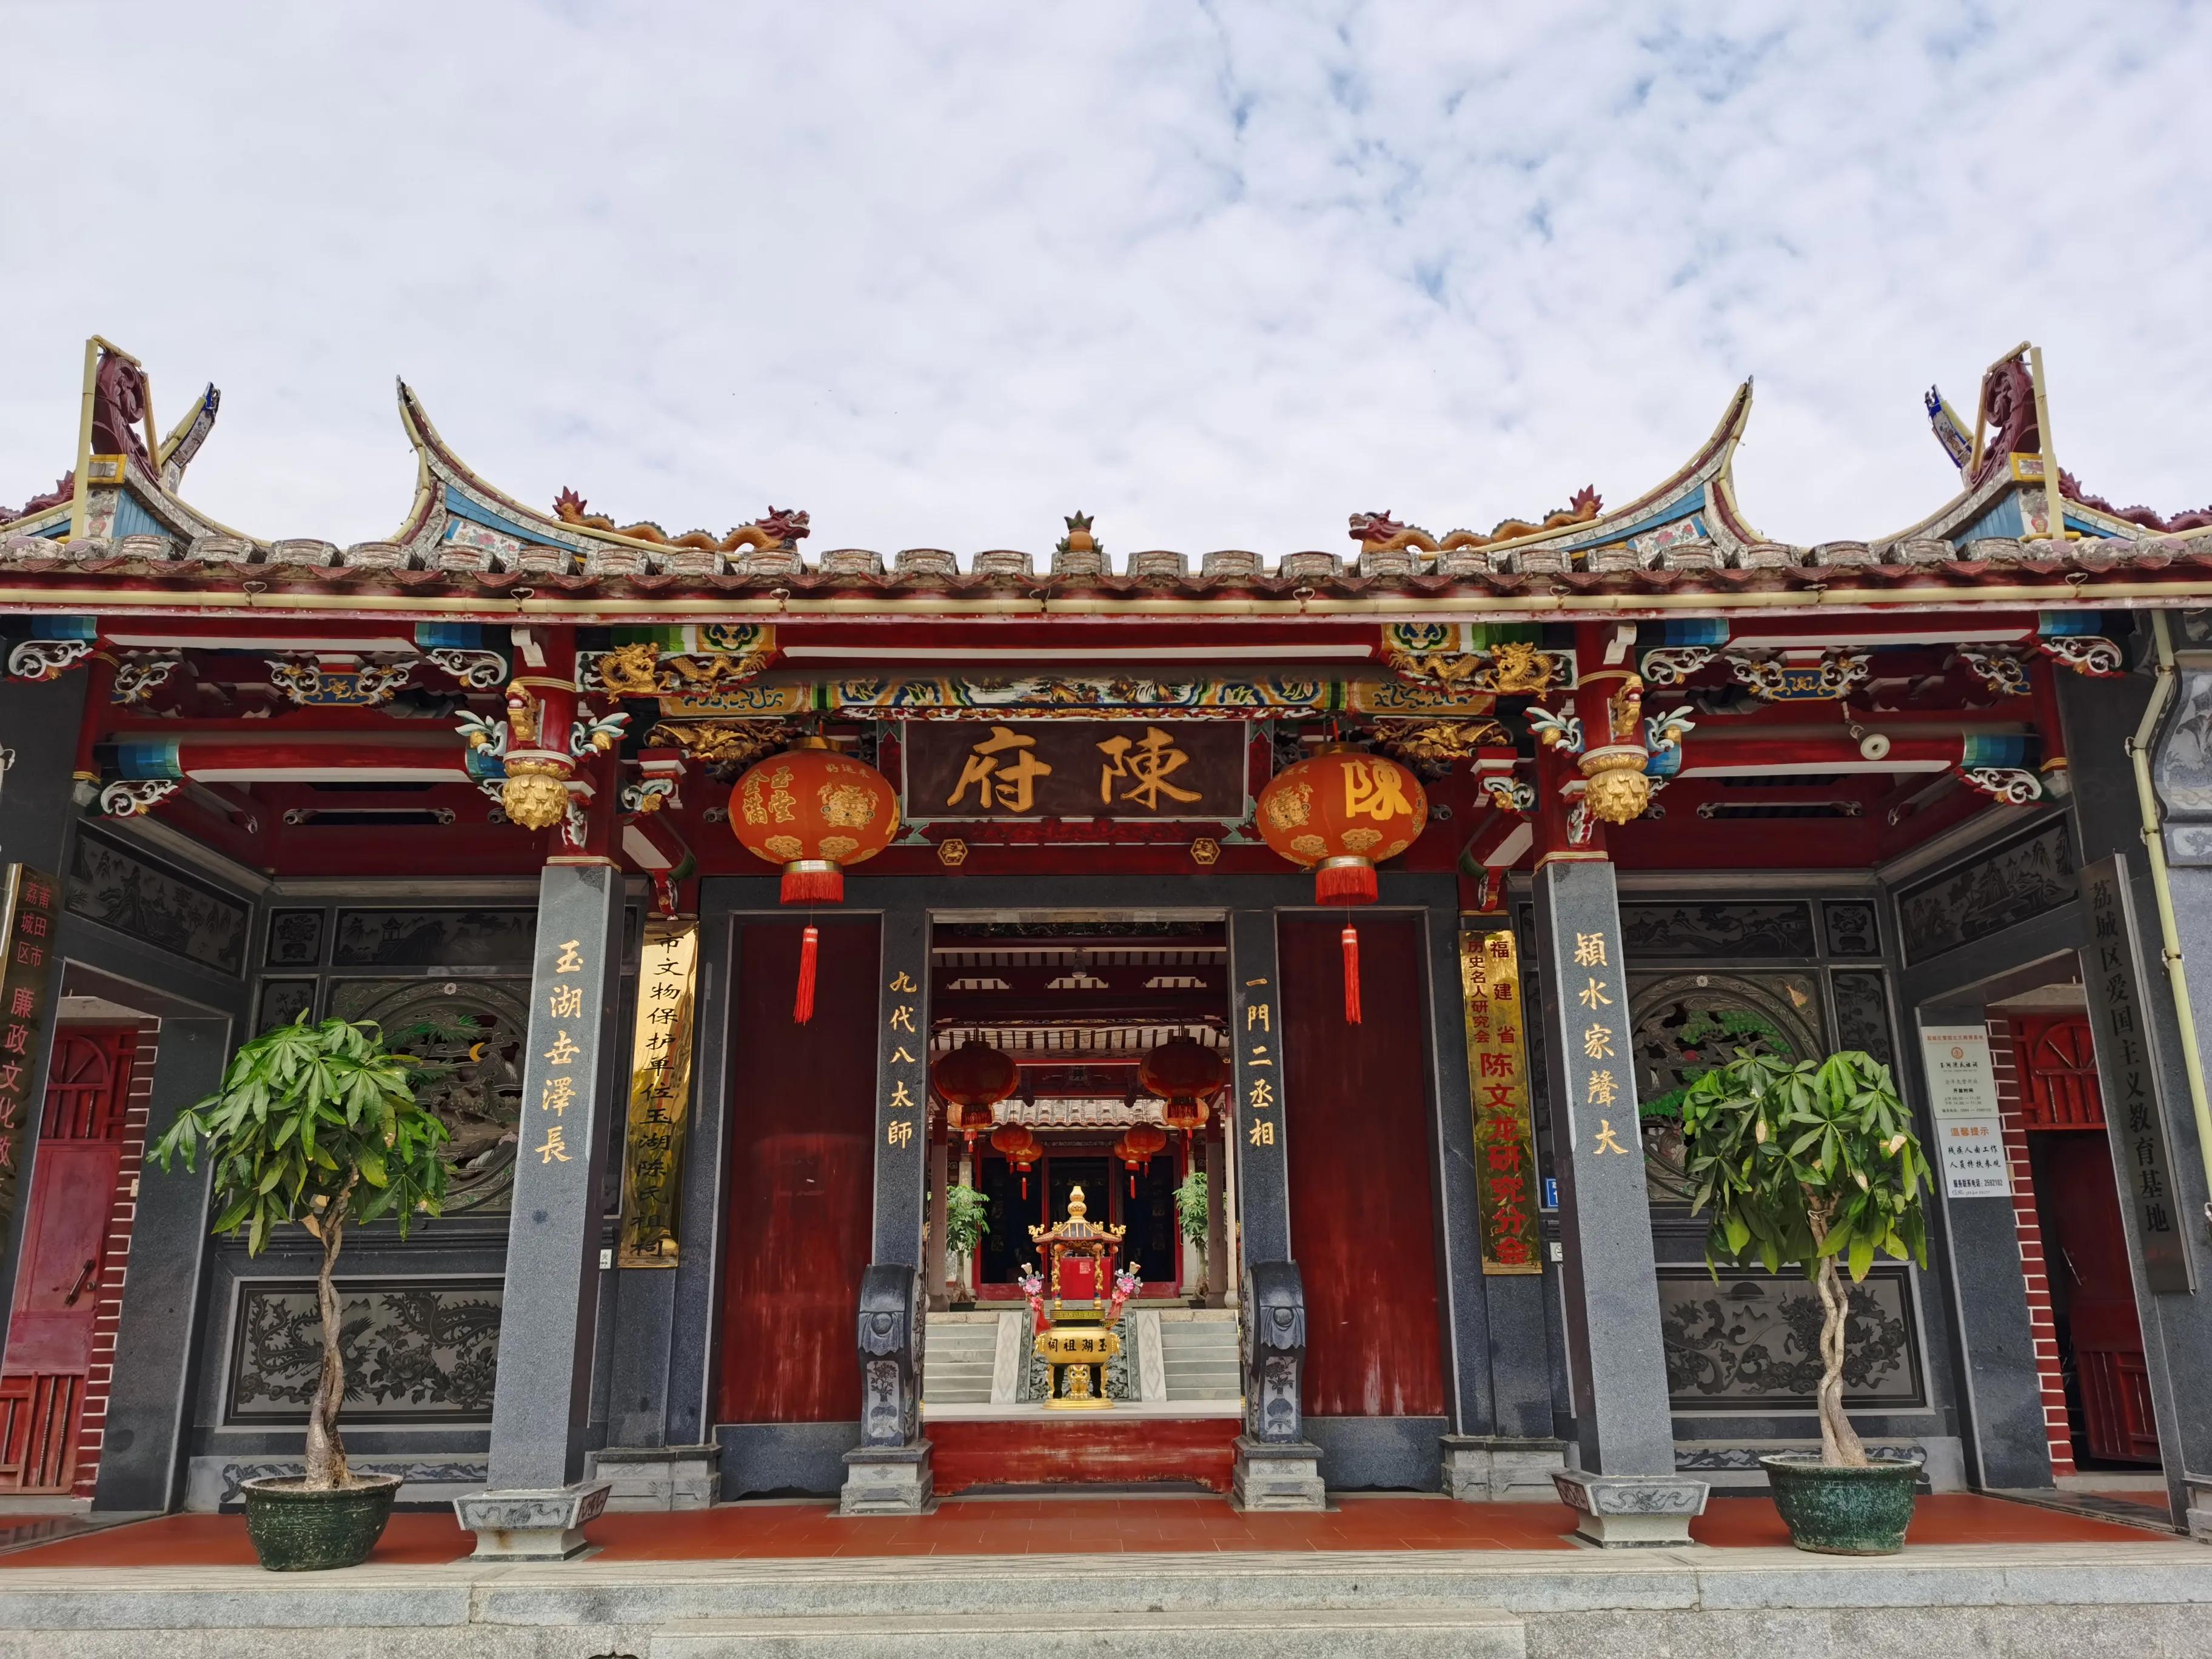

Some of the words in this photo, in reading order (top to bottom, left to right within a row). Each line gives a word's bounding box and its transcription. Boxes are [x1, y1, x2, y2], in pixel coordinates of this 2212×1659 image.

[945, 725, 1203, 813] 陳府
[17, 882, 39, 964] 荔城区
[30, 885, 52, 968] 莆田市
[1467, 940, 1490, 1044] 历史名人研究会
[1490, 940, 1515, 1044] 福建省
[629, 933, 685, 1258] 市文物保护单位玉湖陈氏祖祠
[887, 971, 917, 1149] 九代八太師
[1245, 977, 1275, 1147] 一門二丞相
[2089, 879, 2170, 1232] 荔城区爱国主义教育基地
[1480, 1053, 1529, 1265] 陈文龙研究分会
[1951, 1127, 1989, 1136] 温馨提示
